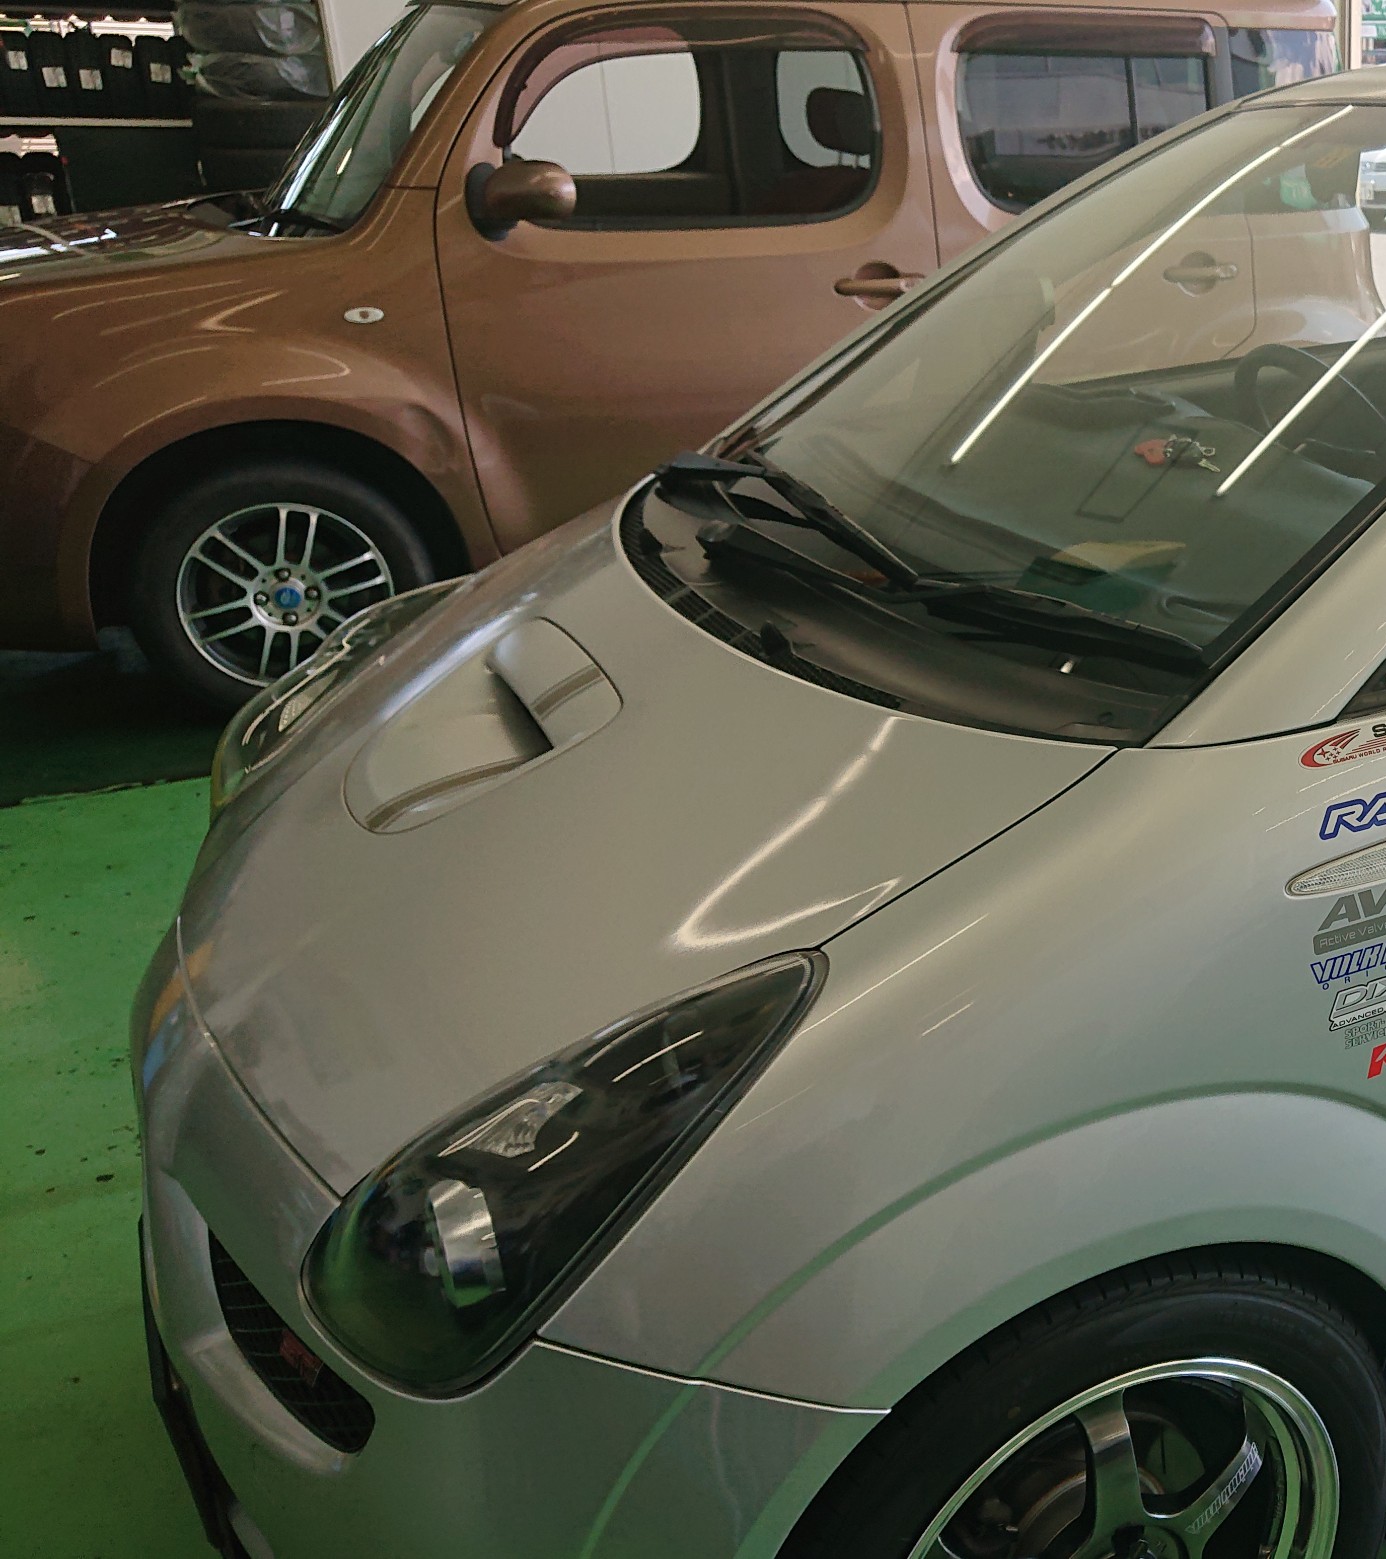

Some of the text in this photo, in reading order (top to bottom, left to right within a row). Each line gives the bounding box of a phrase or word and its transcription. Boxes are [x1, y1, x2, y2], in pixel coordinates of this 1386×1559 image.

[1332, 754, 1357, 764] SUBARU
[1359, 749, 1381, 758] WORLD
[1319, 931, 1357, 948] Active
[1310, 943, 1383, 984] VOLK
[1332, 1007, 1384, 1029] ADVANCED
